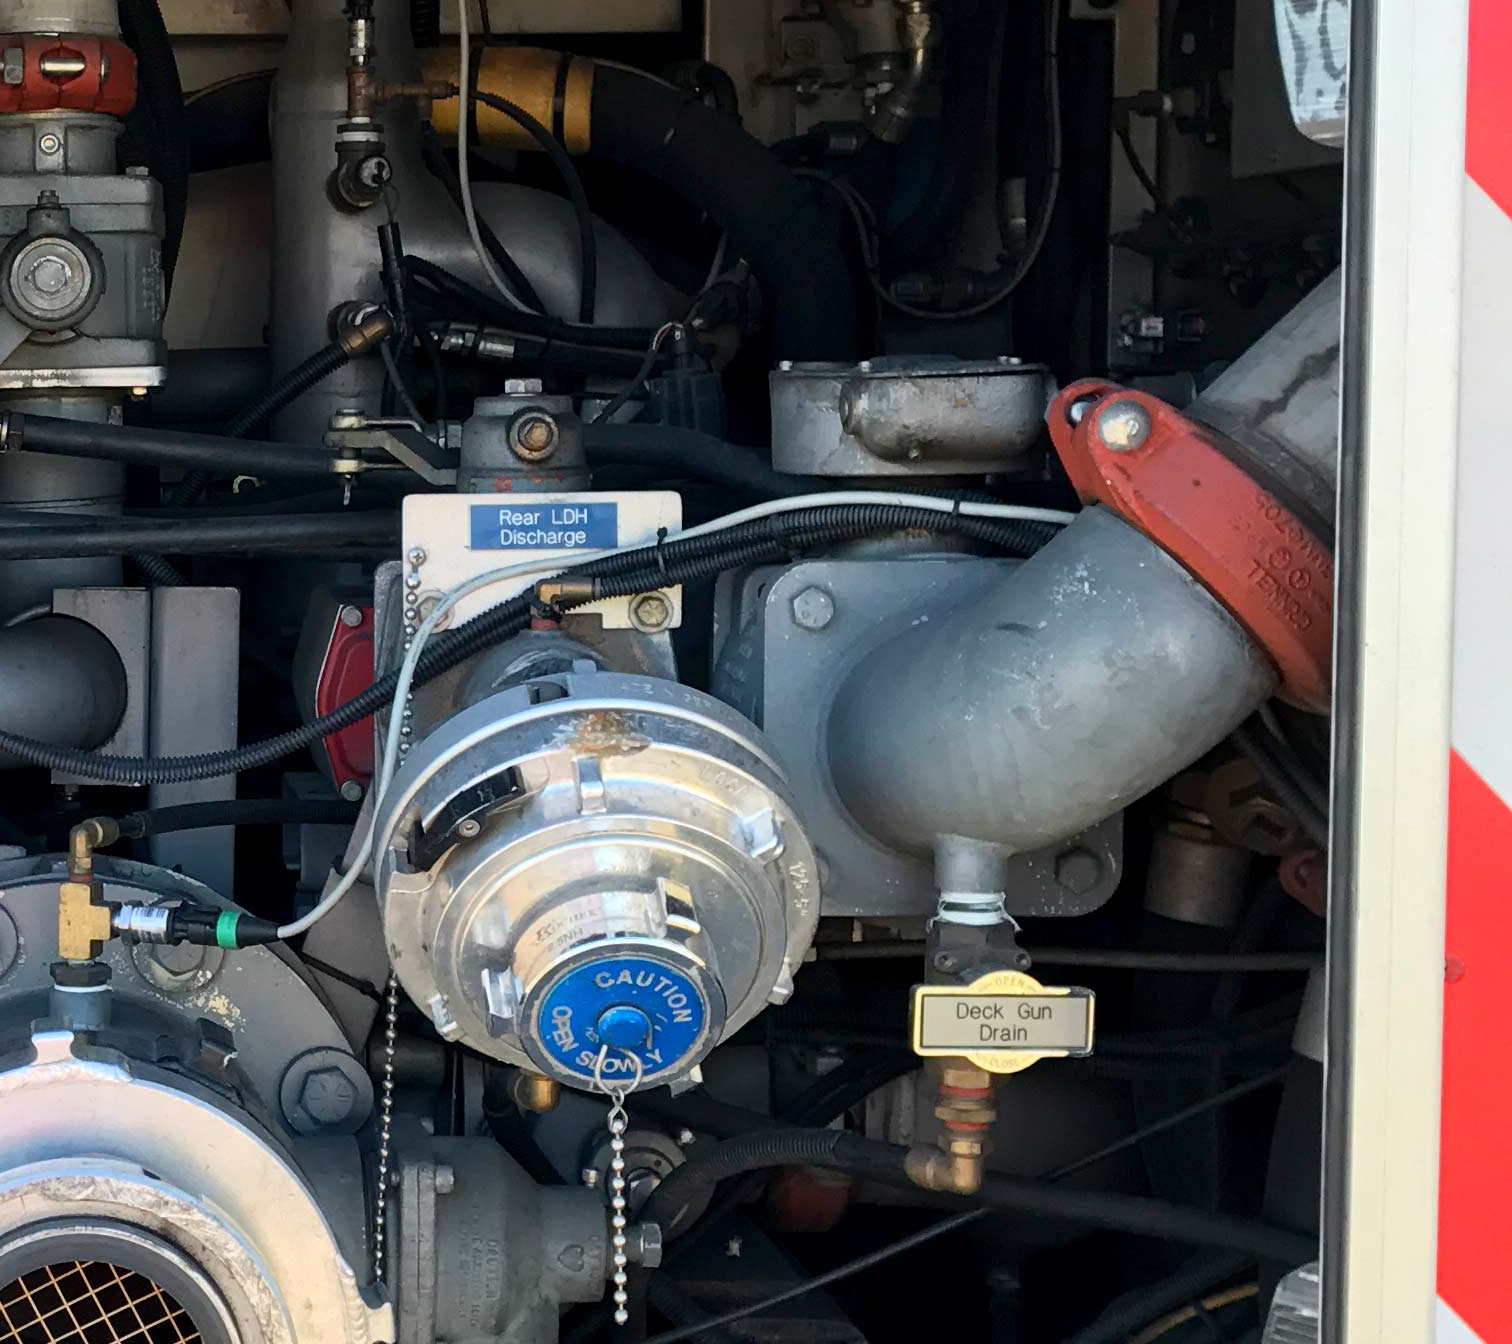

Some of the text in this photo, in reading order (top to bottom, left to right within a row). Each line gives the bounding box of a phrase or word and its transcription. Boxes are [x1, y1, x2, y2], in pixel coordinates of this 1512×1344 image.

[499, 508, 588, 526] Rear LDH
[500, 528, 587, 547] Discharge
[594, 969, 693, 1024] CAUTION
[956, 1002, 1053, 1020] Deck Gun
[551, 1006, 580, 1053] OPEN
[979, 1024, 1028, 1042] Drain
